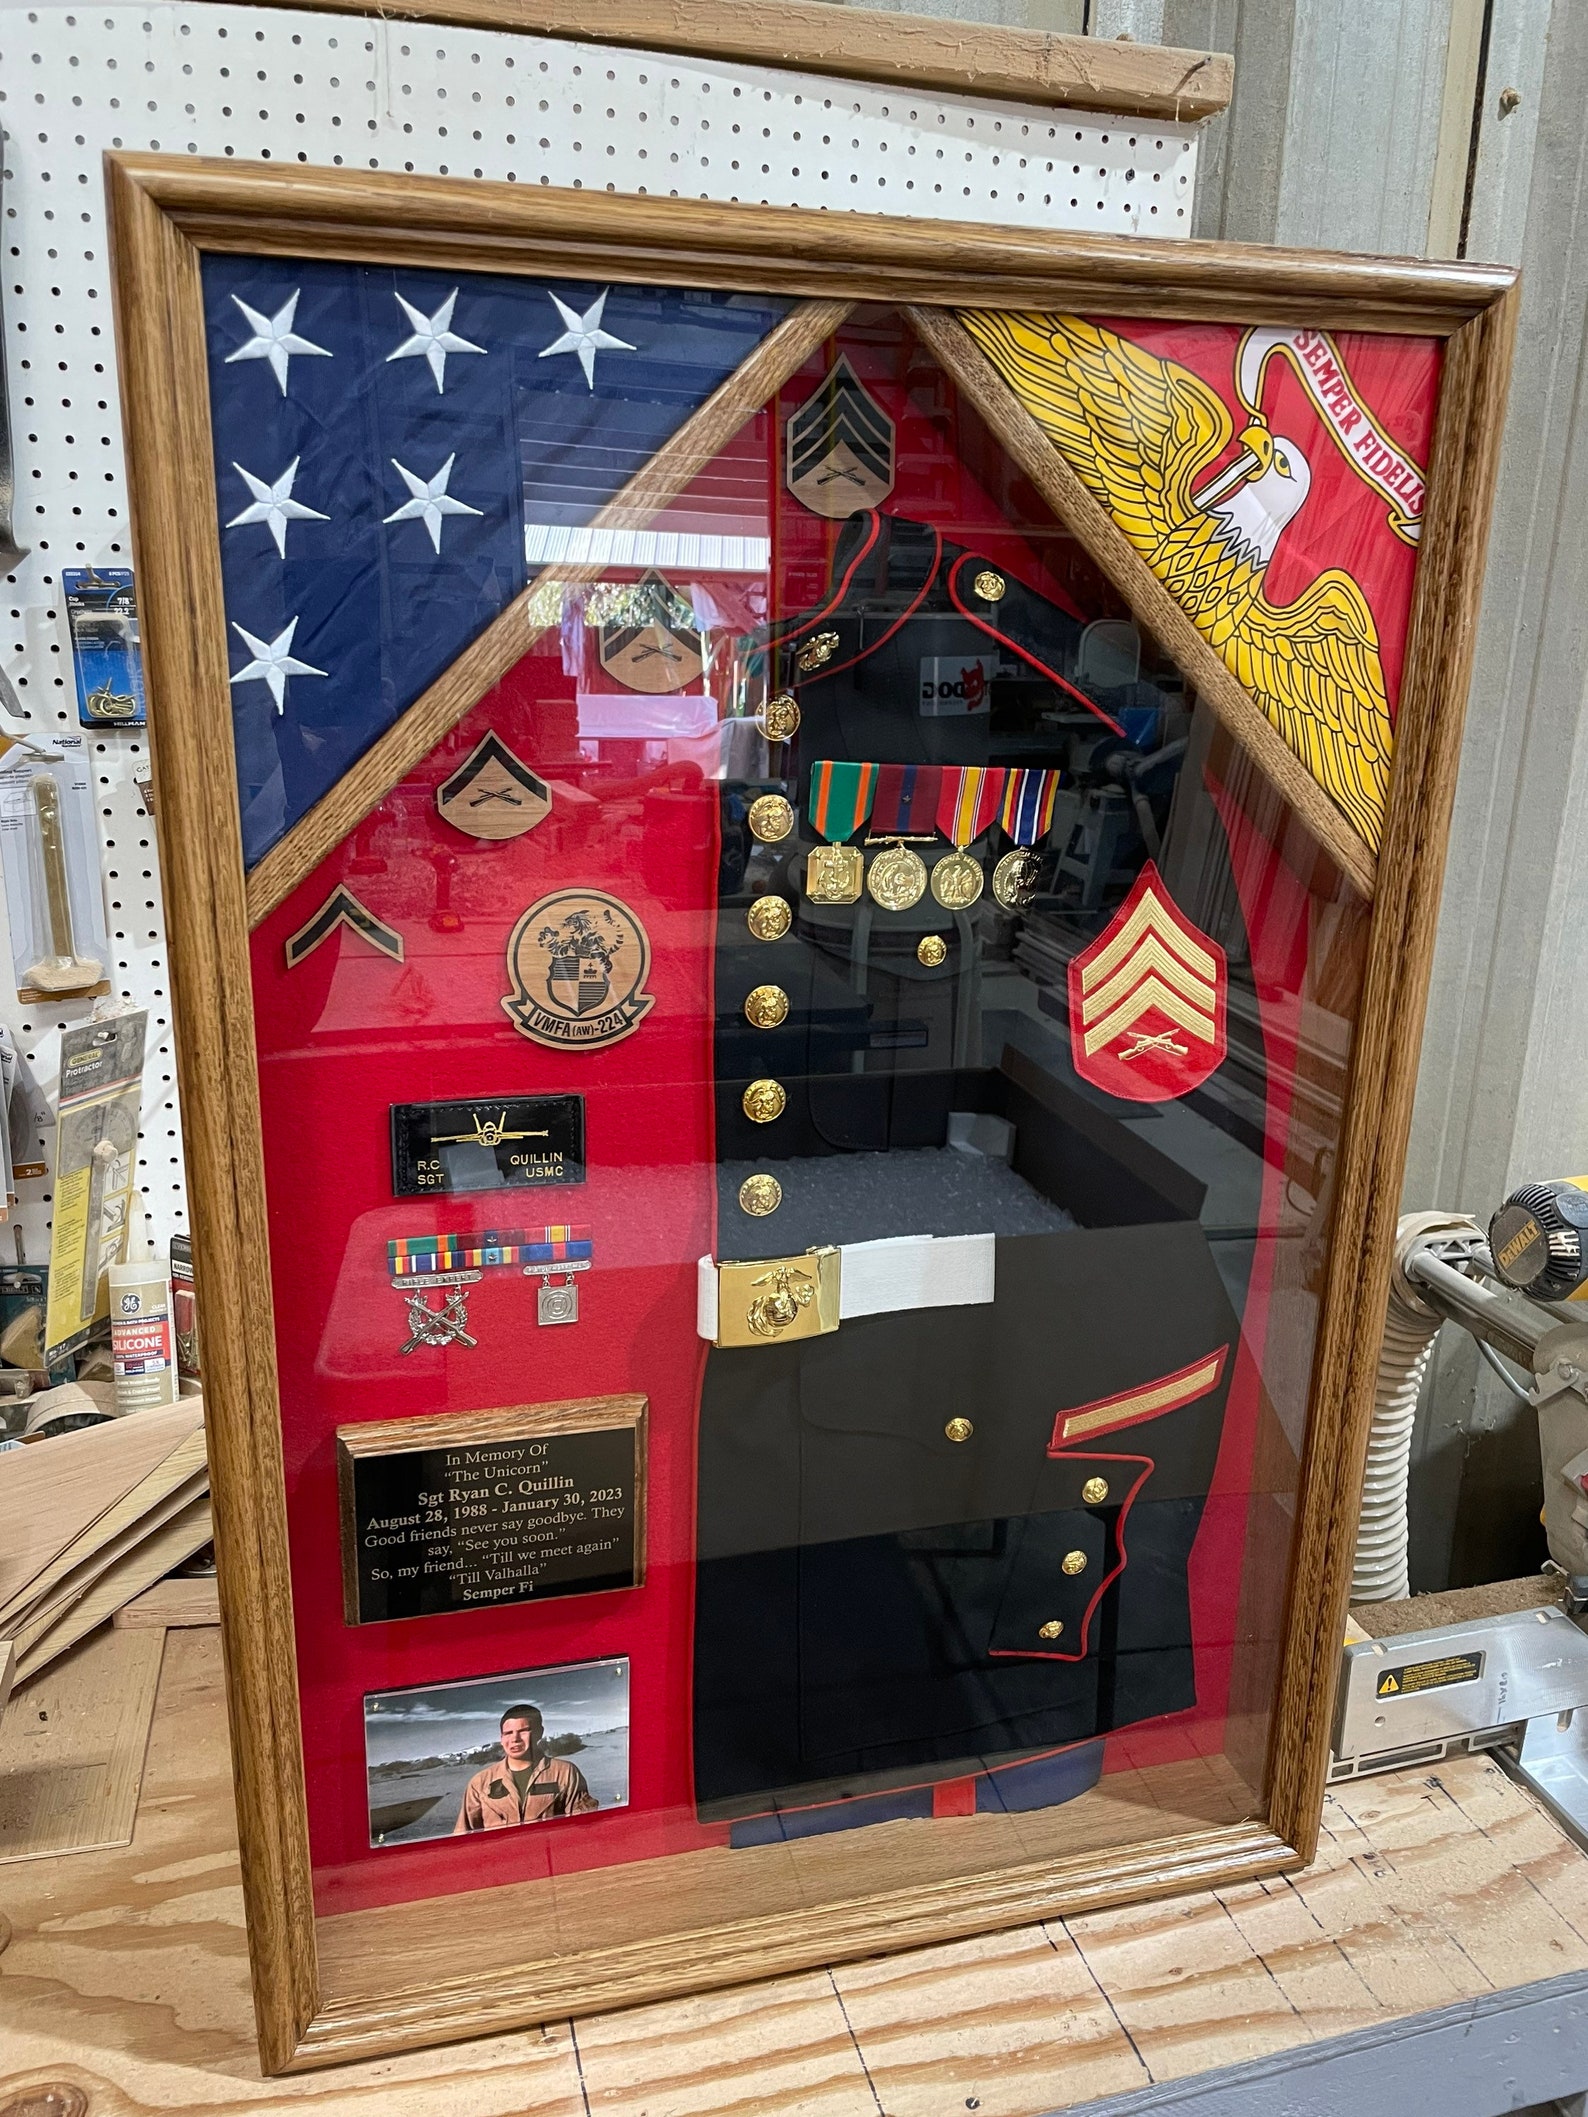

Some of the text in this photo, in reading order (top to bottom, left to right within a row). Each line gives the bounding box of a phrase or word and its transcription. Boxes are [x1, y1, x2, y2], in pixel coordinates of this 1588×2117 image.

[1292, 330, 1425, 516] SEMPER FIDELIS
[533, 1012, 624, 1037] VMFA(AW)-224
[66, 1061, 103, 1078] Protractor
[417, 1151, 564, 1171] R.C QUILLIN
[417, 1165, 564, 1185] SGT USMC
[1498, 1219, 1540, 1268] DEWALT
[401, 1274, 472, 1287] RIFLE EXPERT
[114, 1325, 156, 1336] ADVANCED
[113, 1336, 163, 1351] SILICONE
[446, 1443, 549, 1466] In Memory Of
[444, 1460, 549, 1483] “The Unicorn”
[418, 1476, 574, 1508] Sgt Ryan C. Quillin
[366, 1513, 421, 1531] August
[425, 1509, 448, 1524] 28,
[454, 1503, 488, 1519] 1988
[501, 1497, 559, 1514] January
[563, 1492, 585, 1506] 30,
[589, 1487, 623, 1503] 2023
[365, 1506, 625, 1548] Good friends never say goodbye. They
[428, 1545, 453, 1557] say,
[457, 1539, 489, 1551] “See
[493, 1535, 518, 1550] you
[371, 1568, 393, 1581] So,
[397, 1566, 420, 1578] my
[424, 1557, 478, 1574] friend...
[518, 1549, 537, 1561] we
[540, 1545, 573, 1559] meet
[576, 1537, 620, 1555] again”
[485, 1562, 547, 1581] Valhalla”
[463, 1580, 534, 1601] Semper Fi
